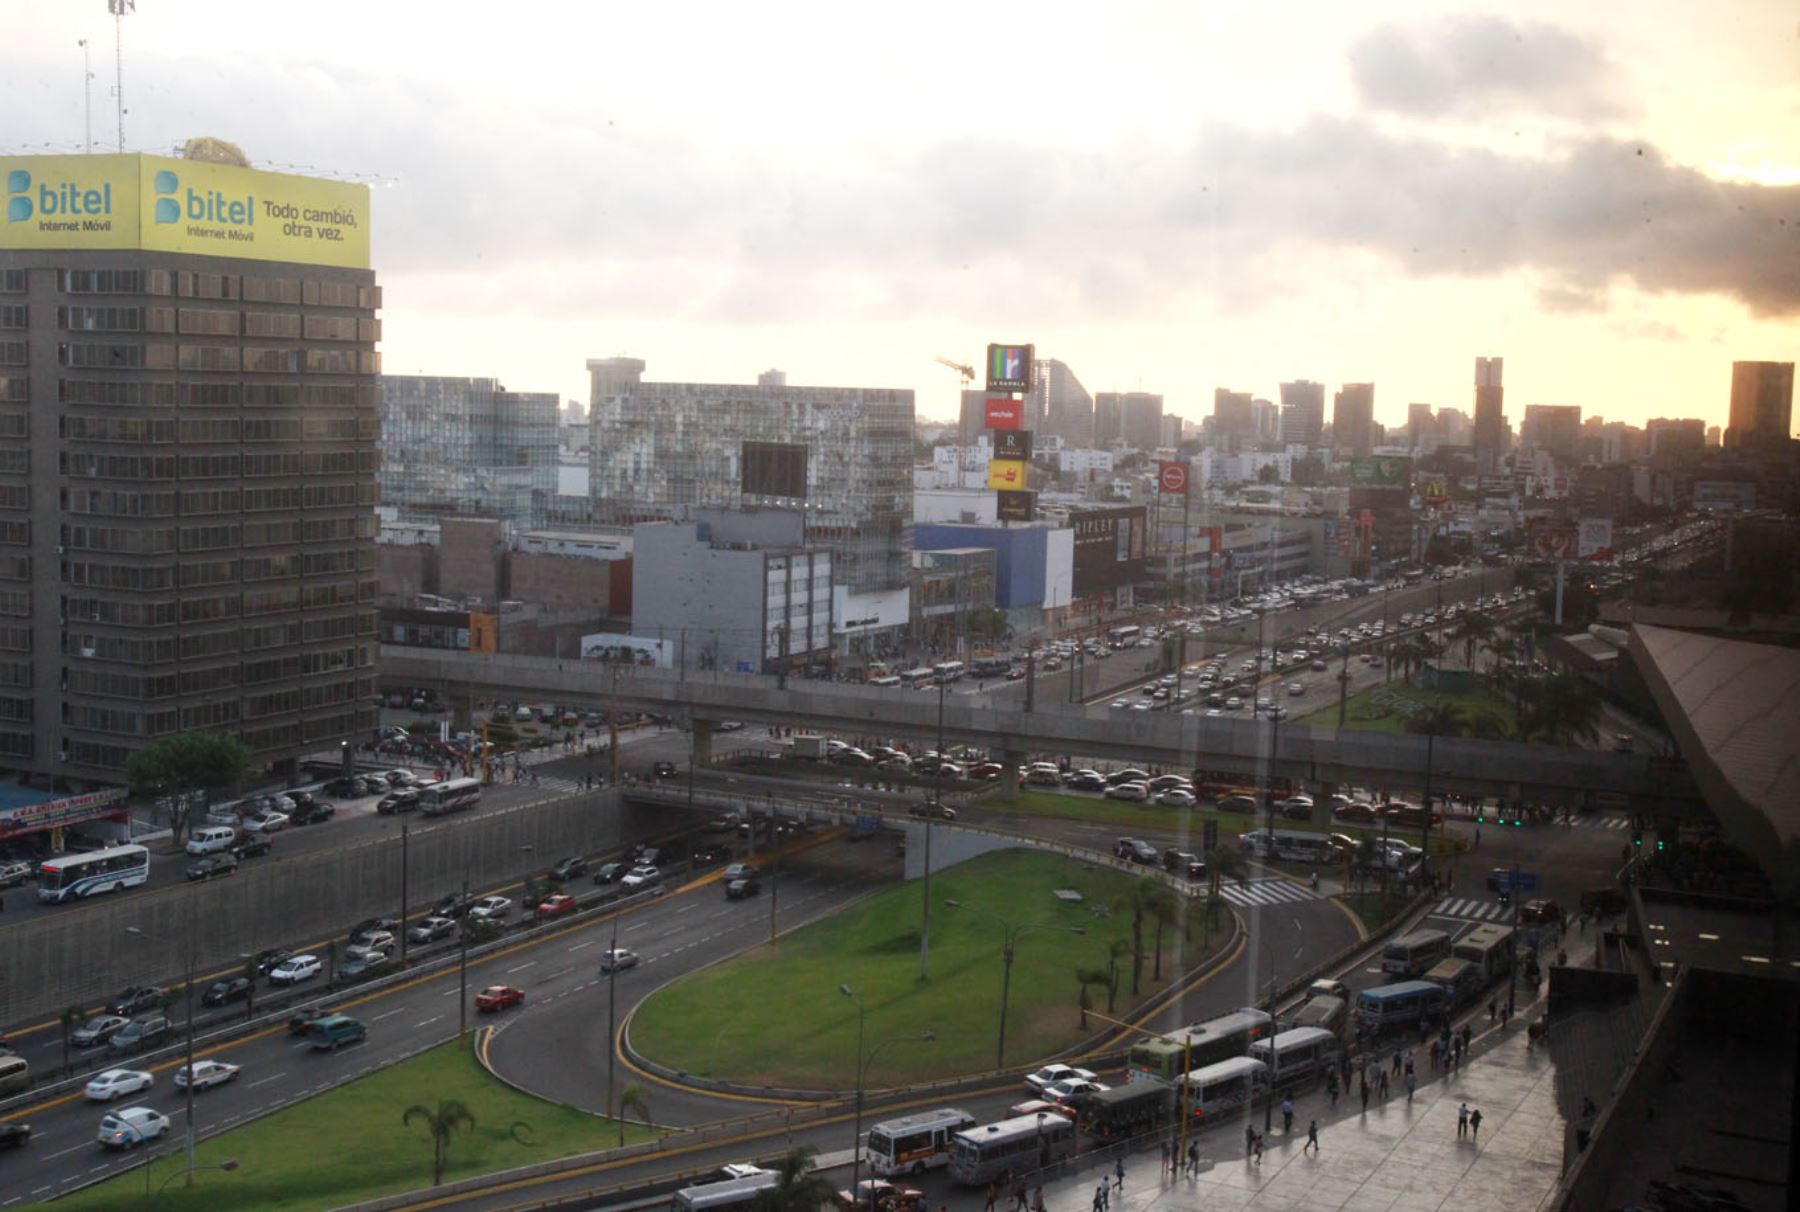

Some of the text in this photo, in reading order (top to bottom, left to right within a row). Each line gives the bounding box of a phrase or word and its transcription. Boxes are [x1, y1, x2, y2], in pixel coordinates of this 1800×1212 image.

[40, 183, 112, 214] bitel
[187, 187, 254, 226] bitel
[263, 200, 299, 220] Todo
[39, 219, 112, 232] Internet Móvil
[187, 225, 254, 242] Internet Móvil
[283, 221, 344, 241] otra vez.
